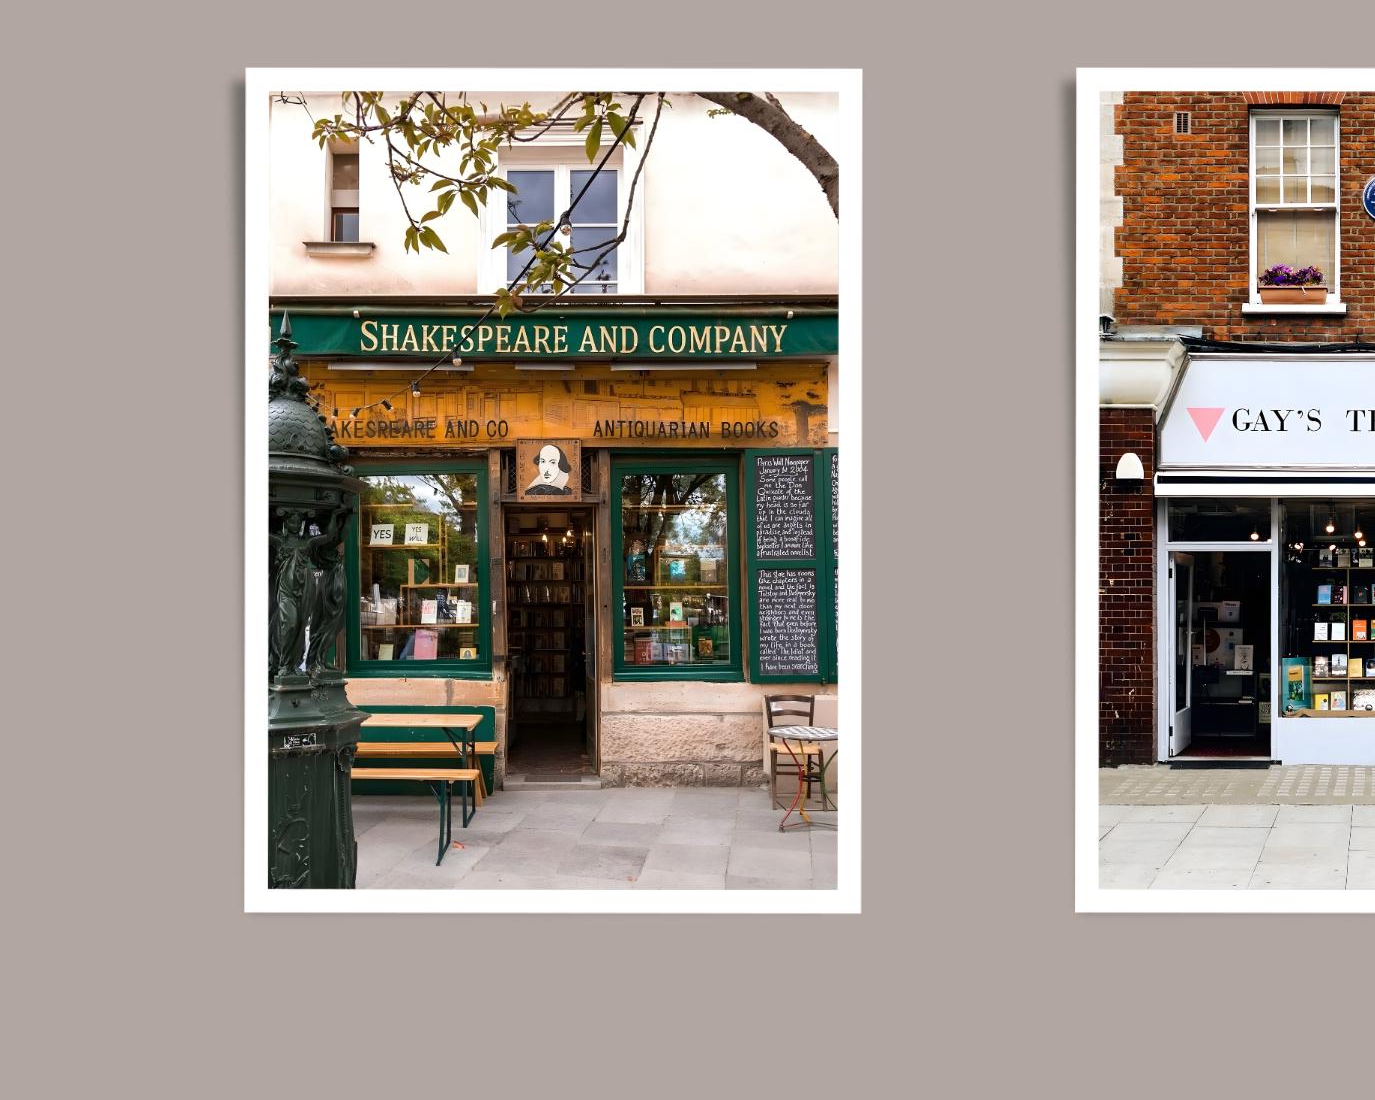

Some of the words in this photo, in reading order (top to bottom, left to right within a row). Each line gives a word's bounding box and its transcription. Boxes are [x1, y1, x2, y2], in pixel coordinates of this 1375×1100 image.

[360, 320, 568, 353] SHAKESPEARE
[578, 325, 639, 353] AND
[649, 325, 787, 353] COMPANY
[444, 420, 480, 438] AND
[486, 420, 509, 438] CO
[593, 420, 710, 438] ANTIQUARIAN
[721, 420, 779, 438] BOOKS
[1231, 407, 1323, 433] GAY'S
[373, 529, 391, 539] YES
